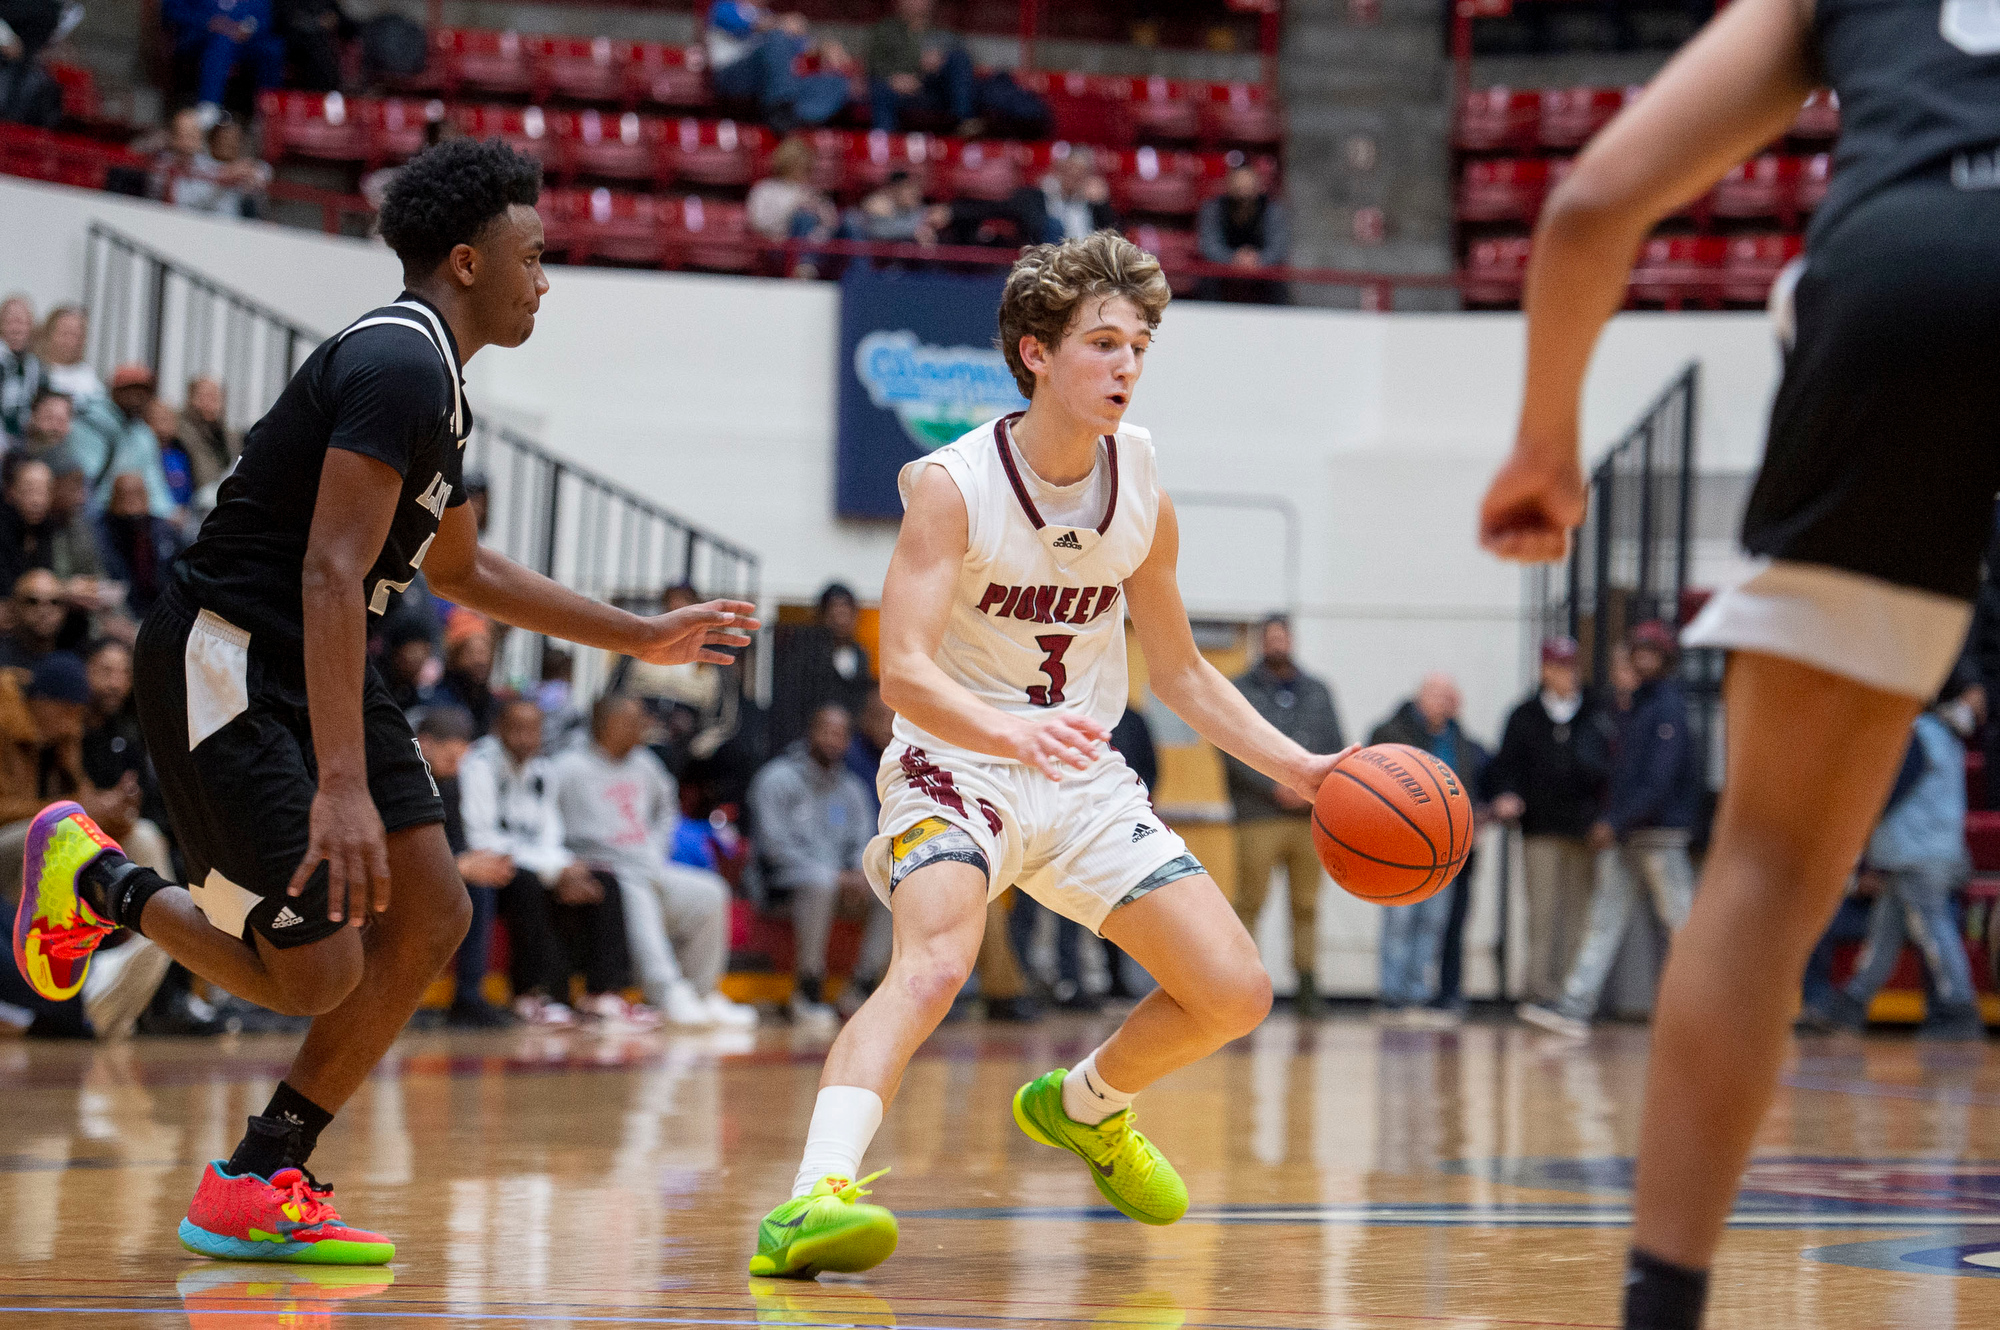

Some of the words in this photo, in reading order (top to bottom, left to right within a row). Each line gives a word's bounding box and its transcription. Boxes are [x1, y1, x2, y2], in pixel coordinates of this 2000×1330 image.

[1053, 541, 1083, 550] adidas
[1026, 634, 1078, 706] 3
[1132, 828, 1158, 843] adidas
[272, 916, 304, 929] adidas
